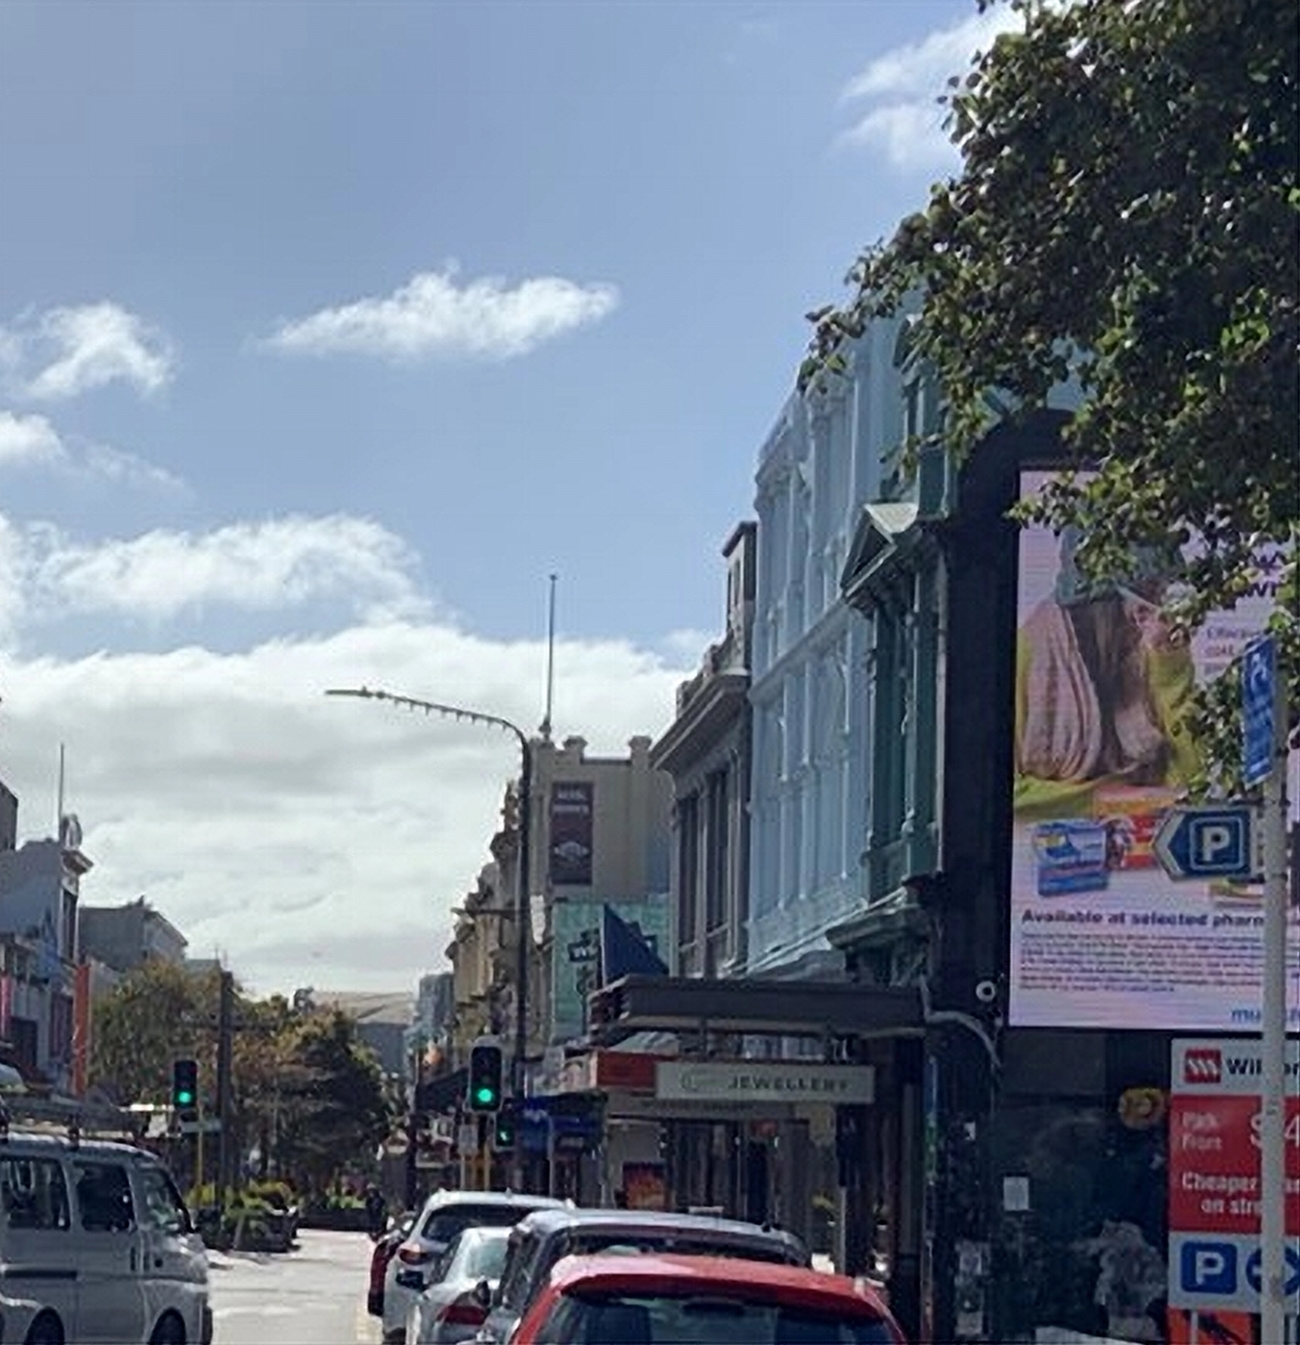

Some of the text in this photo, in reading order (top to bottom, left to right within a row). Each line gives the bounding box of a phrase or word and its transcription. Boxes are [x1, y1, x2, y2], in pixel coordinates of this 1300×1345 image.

[1202, 826, 1231, 862] P
[1020, 909, 1102, 925] Available
[1107, 911, 1125, 925] at
[1130, 911, 1208, 926] selected
[1226, 1056, 1300, 1076] Wilo
[727, 1075, 850, 1093] JEWELLERY
[1182, 1171, 1257, 1197] Cheaper
[1201, 1199, 1225, 1214] on
[1195, 1251, 1225, 1287] P
